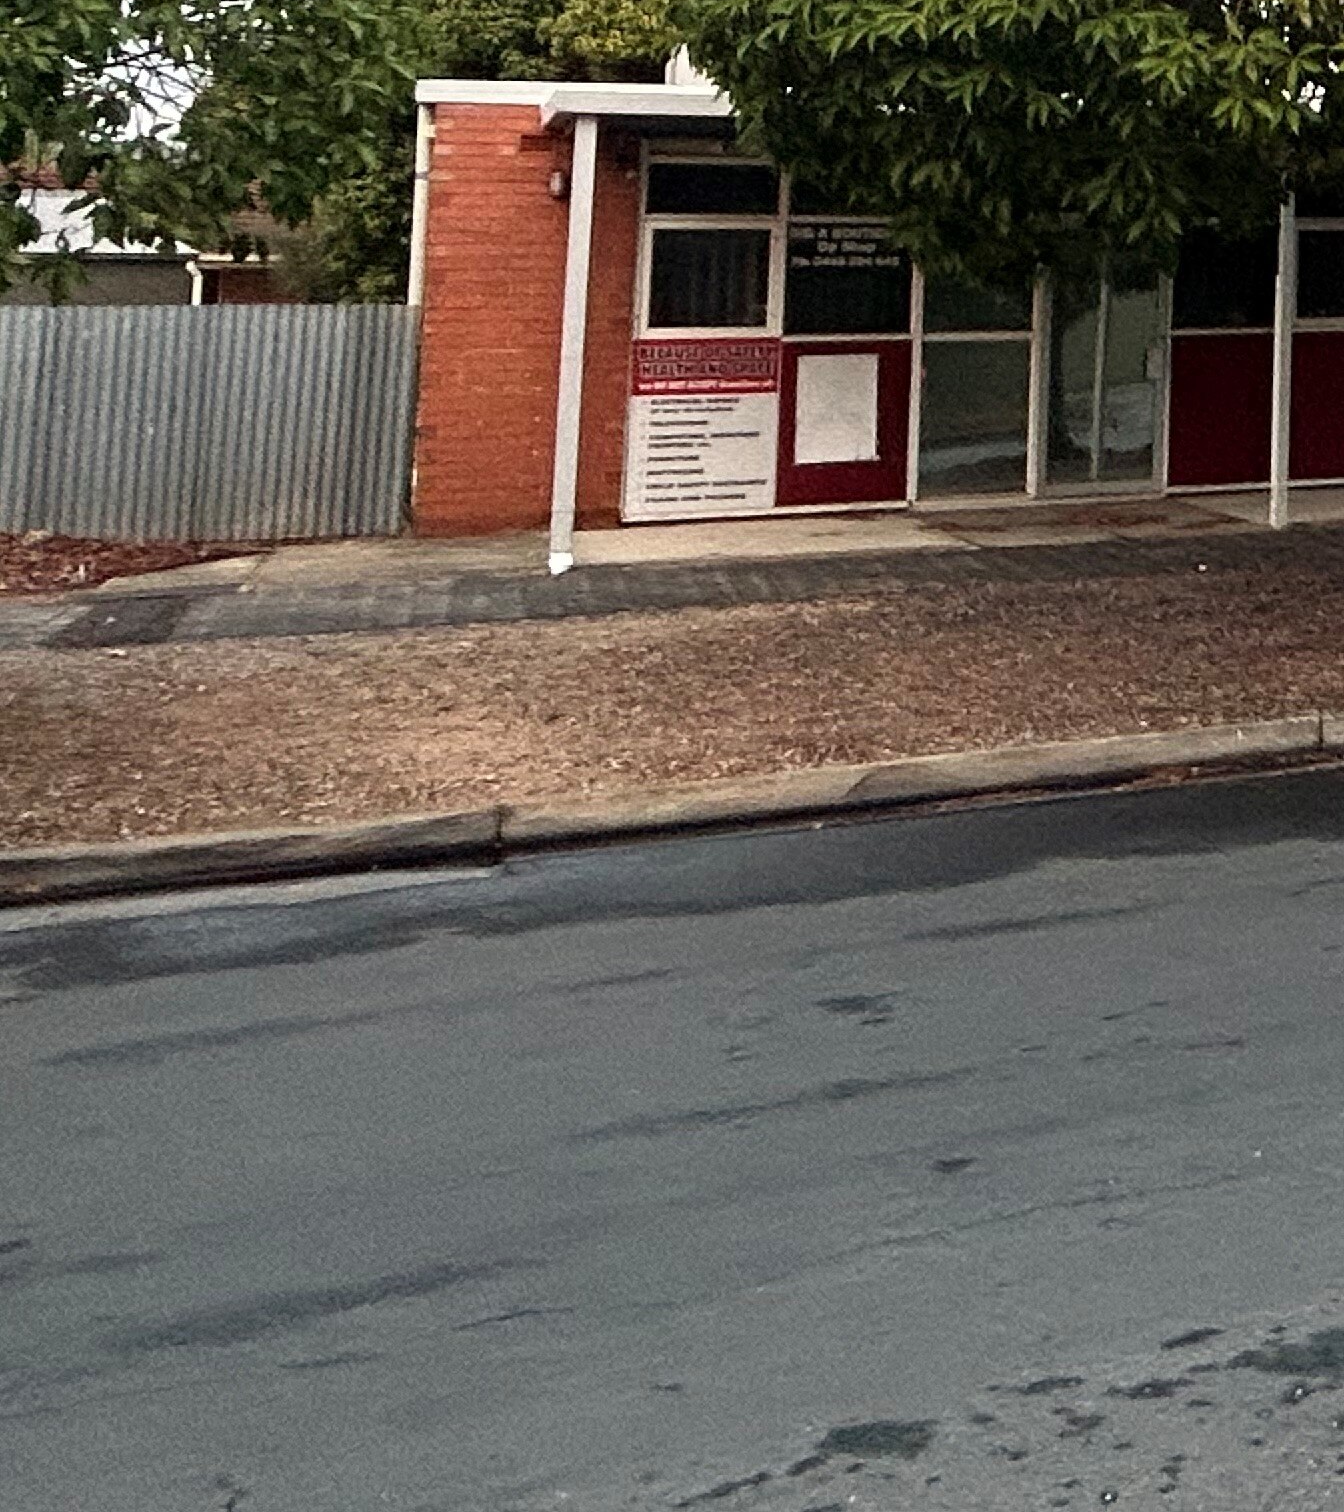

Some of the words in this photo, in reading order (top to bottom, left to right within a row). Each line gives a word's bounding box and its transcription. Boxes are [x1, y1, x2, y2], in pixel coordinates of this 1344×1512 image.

[640, 346, 698, 359] BECAUSE
[704, 345, 720, 358] OF
[641, 363, 693, 376] HEALTH
[699, 362, 728, 375] AND
